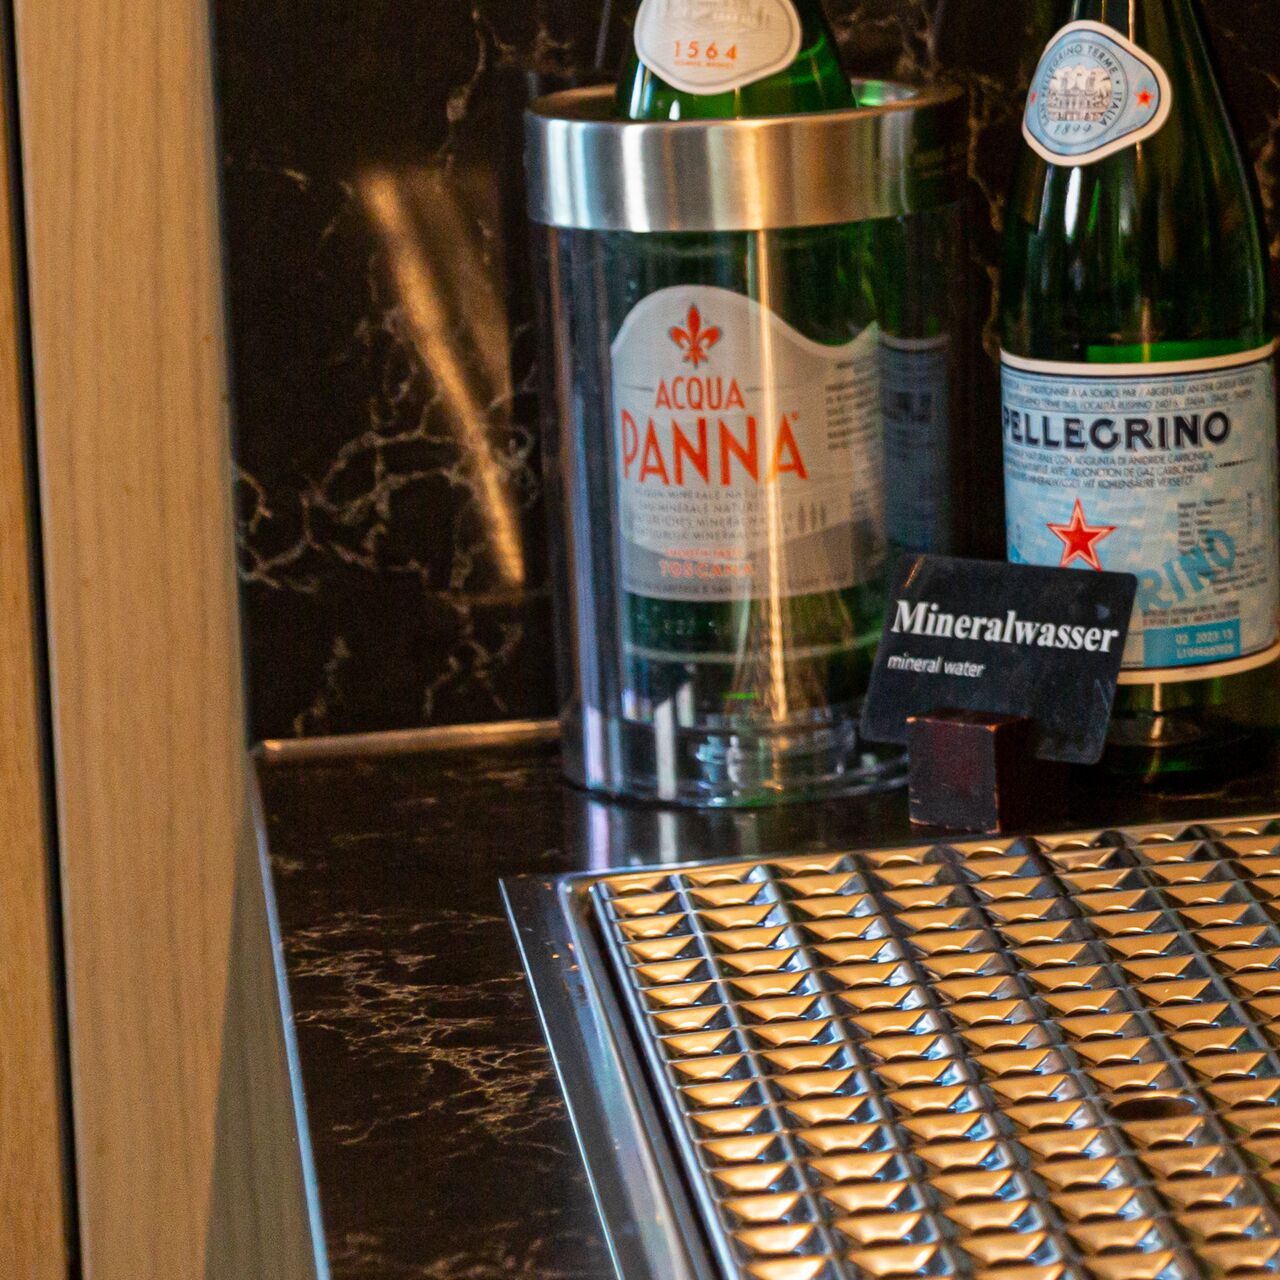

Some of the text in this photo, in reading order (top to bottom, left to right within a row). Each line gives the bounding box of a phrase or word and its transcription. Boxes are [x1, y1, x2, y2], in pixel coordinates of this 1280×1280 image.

[673, 40, 738, 61] 1564
[1087, 45, 1119, 74] TERME
[1100, 91, 1123, 127] ITALIA
[655, 376, 745, 410] ACQUA
[620, 408, 809, 487] PANNA
[891, 600, 1119, 653] Mineralwasser
[887, 652, 986, 678] mineral water
